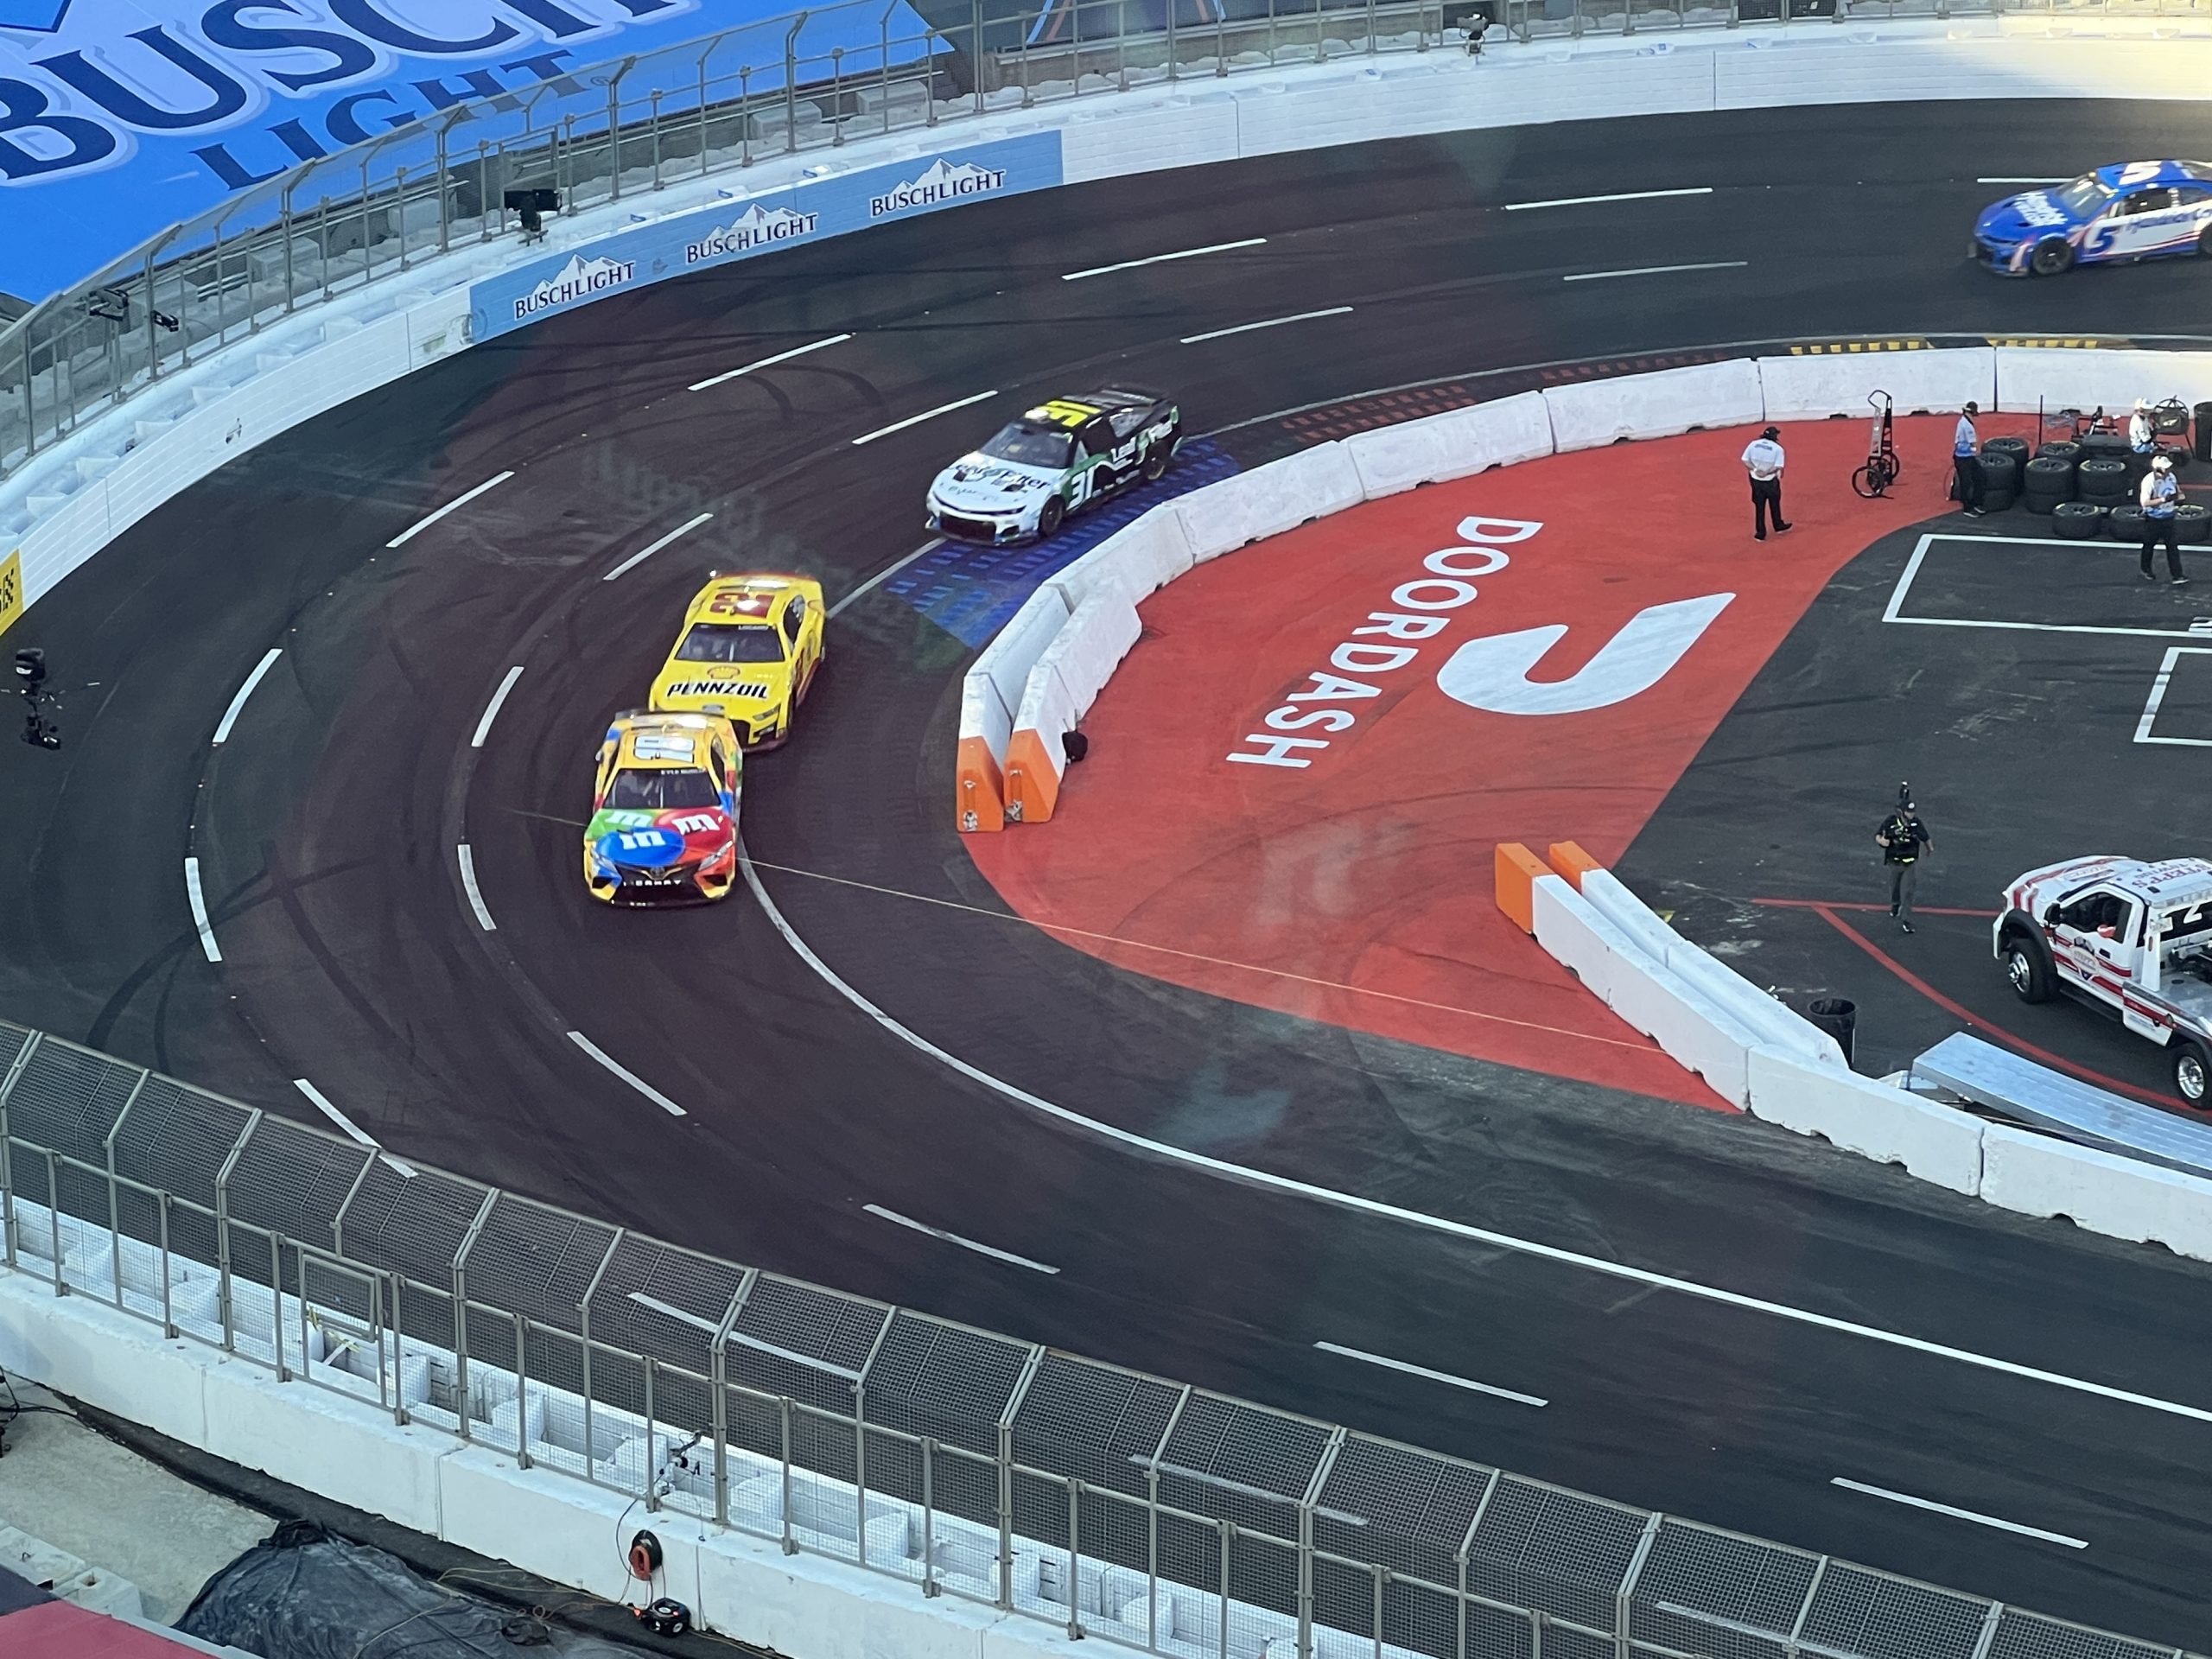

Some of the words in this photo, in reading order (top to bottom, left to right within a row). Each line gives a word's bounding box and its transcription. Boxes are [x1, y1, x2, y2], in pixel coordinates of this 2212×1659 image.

[189, 49, 594, 191] LIGHT
[2085, 225, 2123, 253] 5
[1226, 516, 1544, 768] DOORDASH
[666, 682, 767, 699] PENNZOIL
[619, 830, 666, 850] m
